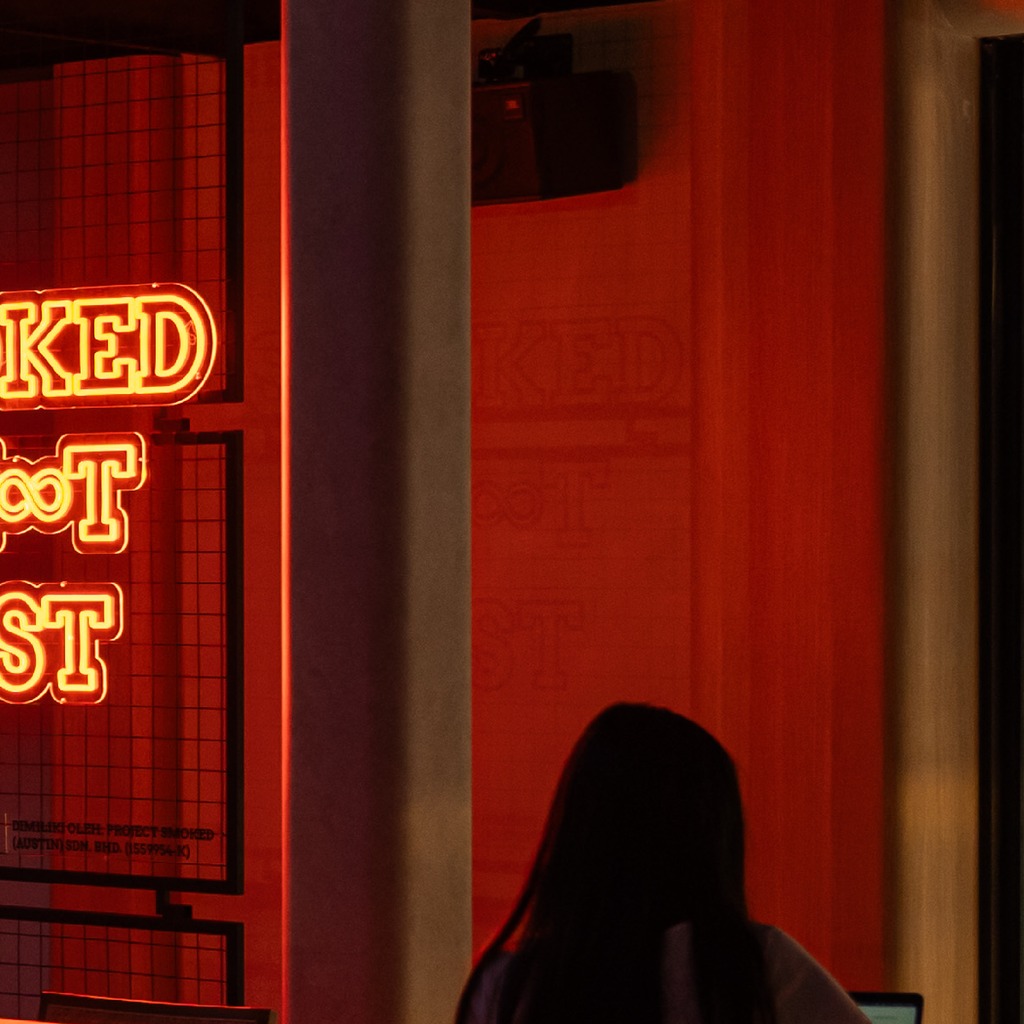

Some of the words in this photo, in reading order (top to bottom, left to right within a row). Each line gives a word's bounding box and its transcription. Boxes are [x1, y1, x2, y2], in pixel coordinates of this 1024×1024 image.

[107, 824, 158, 838] PROJECT
[160, 827, 215, 840] SMOKED
[12, 836, 64, 852] (AUSTIN)
